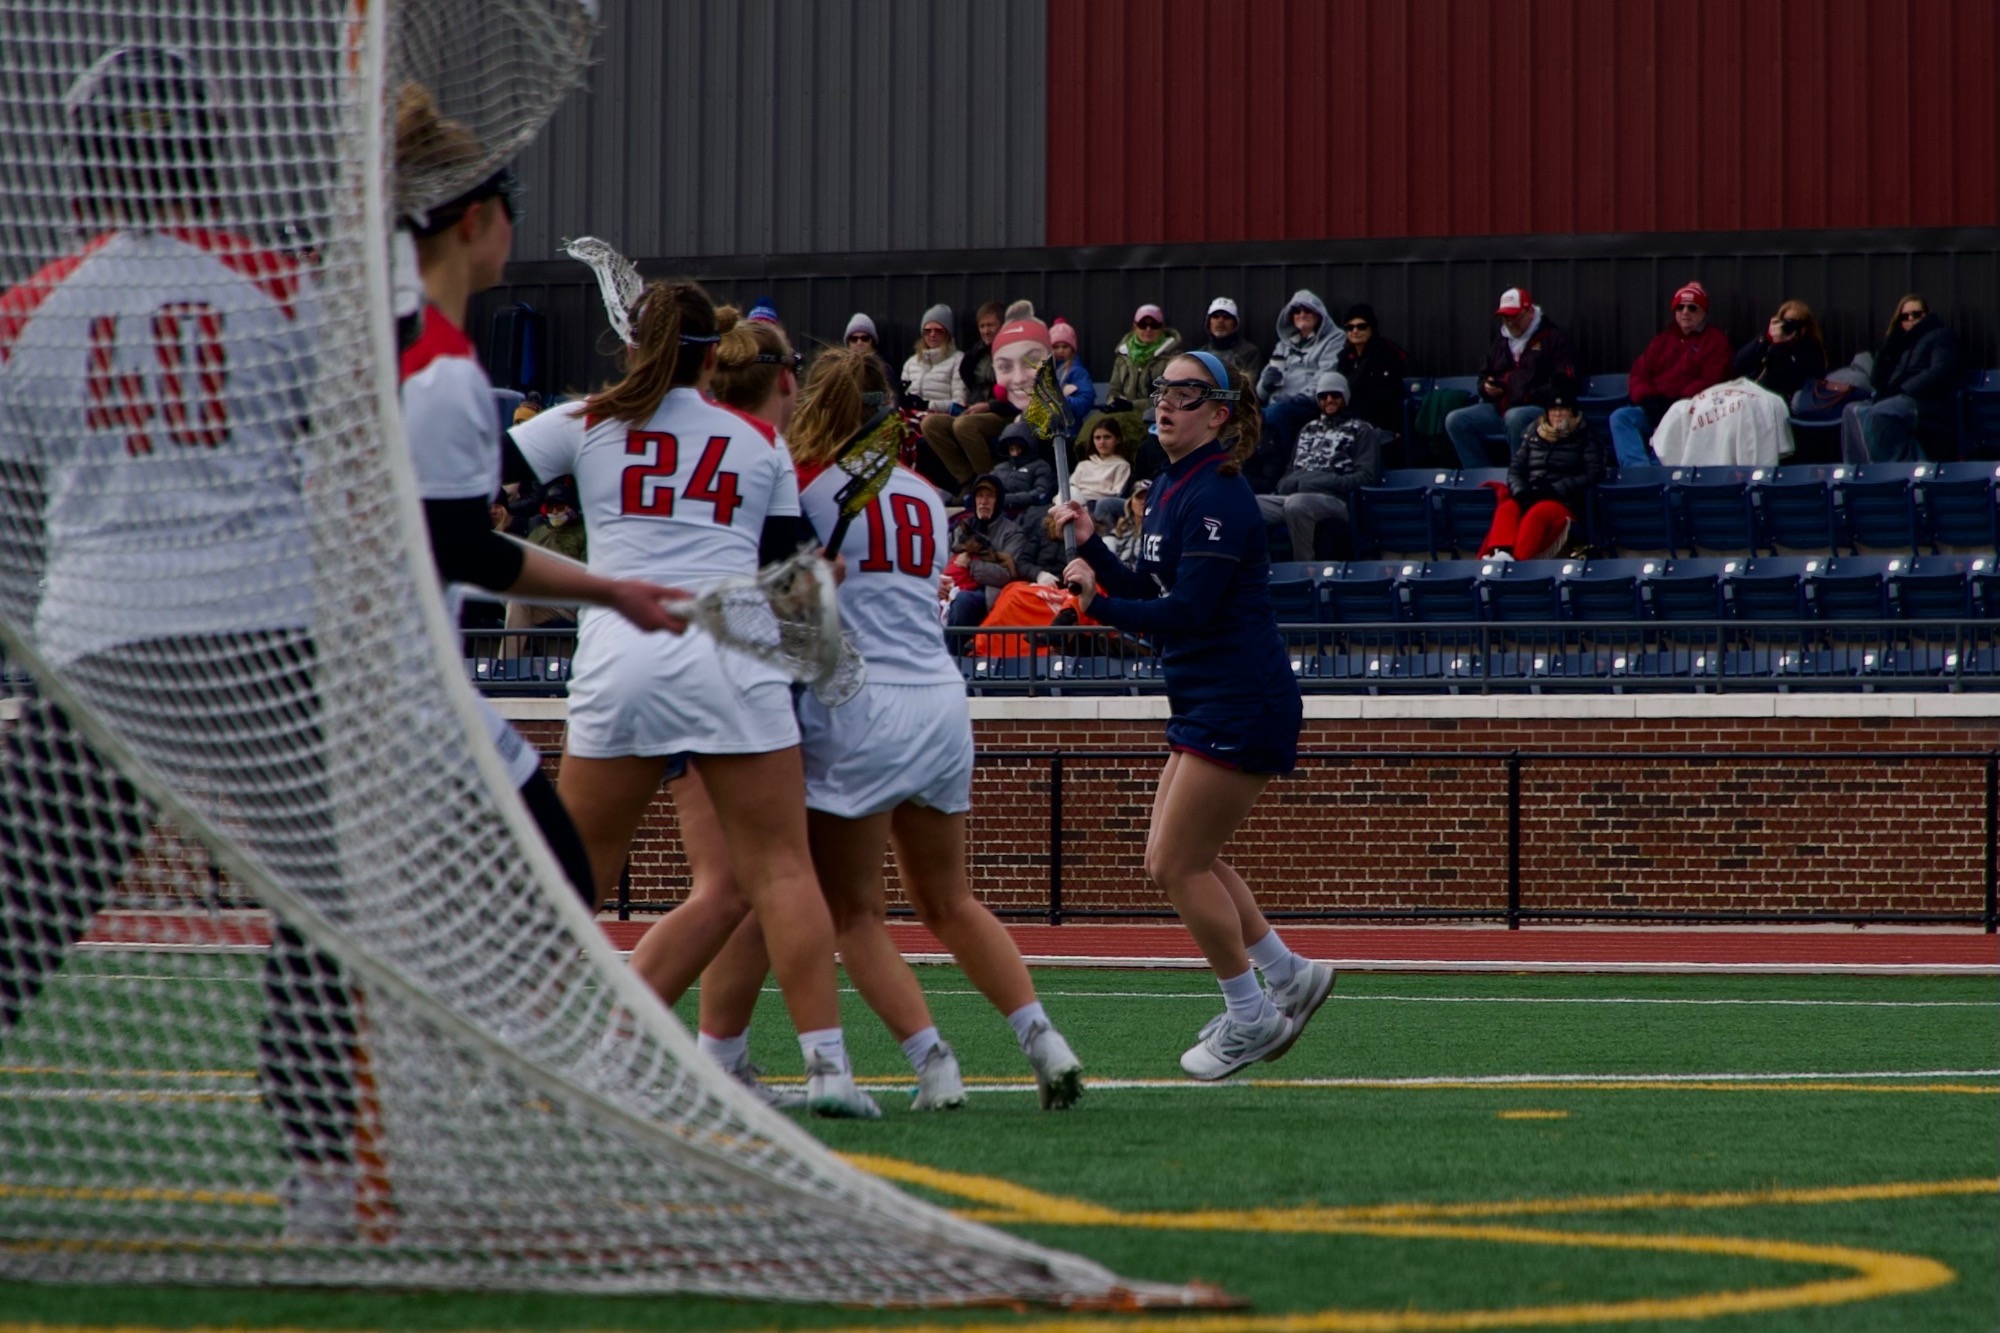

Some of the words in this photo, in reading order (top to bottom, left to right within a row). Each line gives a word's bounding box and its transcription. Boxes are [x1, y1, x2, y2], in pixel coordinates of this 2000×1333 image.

[86, 301, 231, 458] 40
[621, 430, 743, 526] 24
[859, 493, 936, 578] 18
